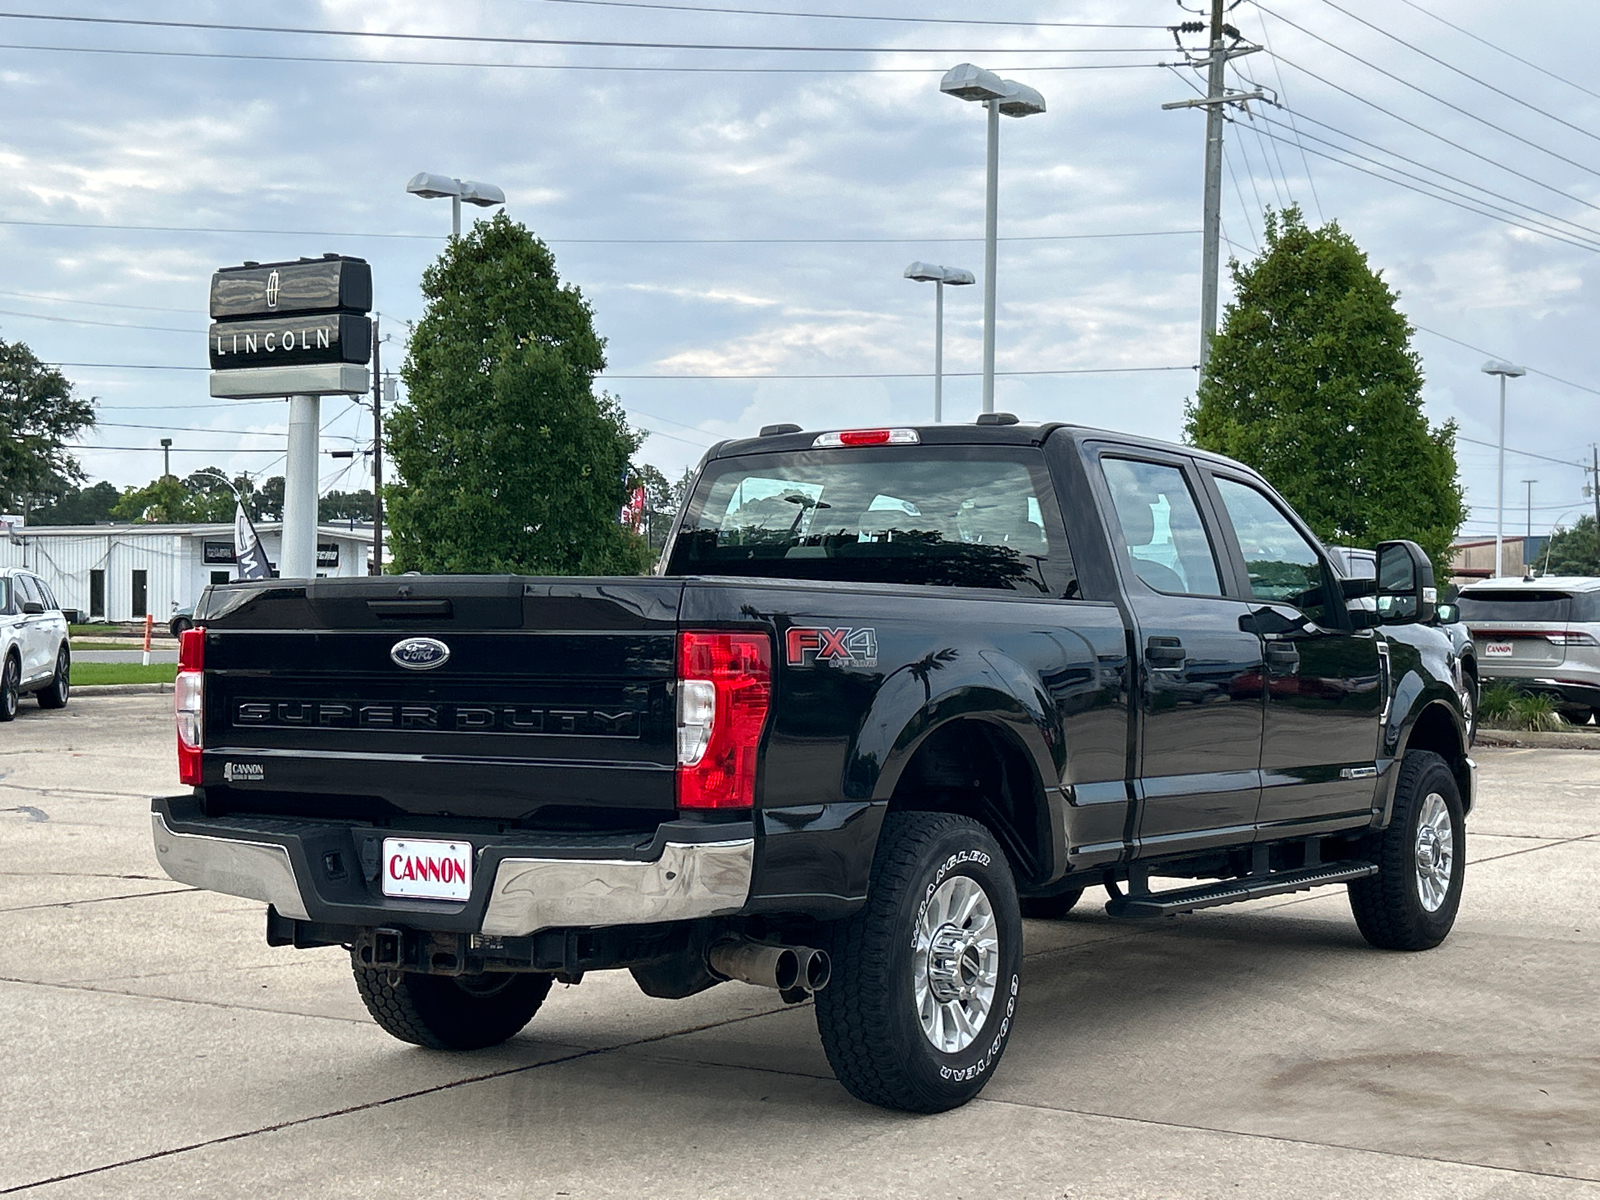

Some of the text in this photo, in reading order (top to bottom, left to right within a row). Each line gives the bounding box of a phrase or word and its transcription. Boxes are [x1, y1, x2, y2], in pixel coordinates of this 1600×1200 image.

[217, 328, 330, 356] LINCOLN
[402, 643, 435, 660] Ford
[785, 626, 878, 667] FX4
[1486, 645, 1512, 653] CANNON
[238, 702, 634, 731] SUPER DUTY
[232, 763, 264, 774] CANNON
[388, 853, 467, 885] CANNON
